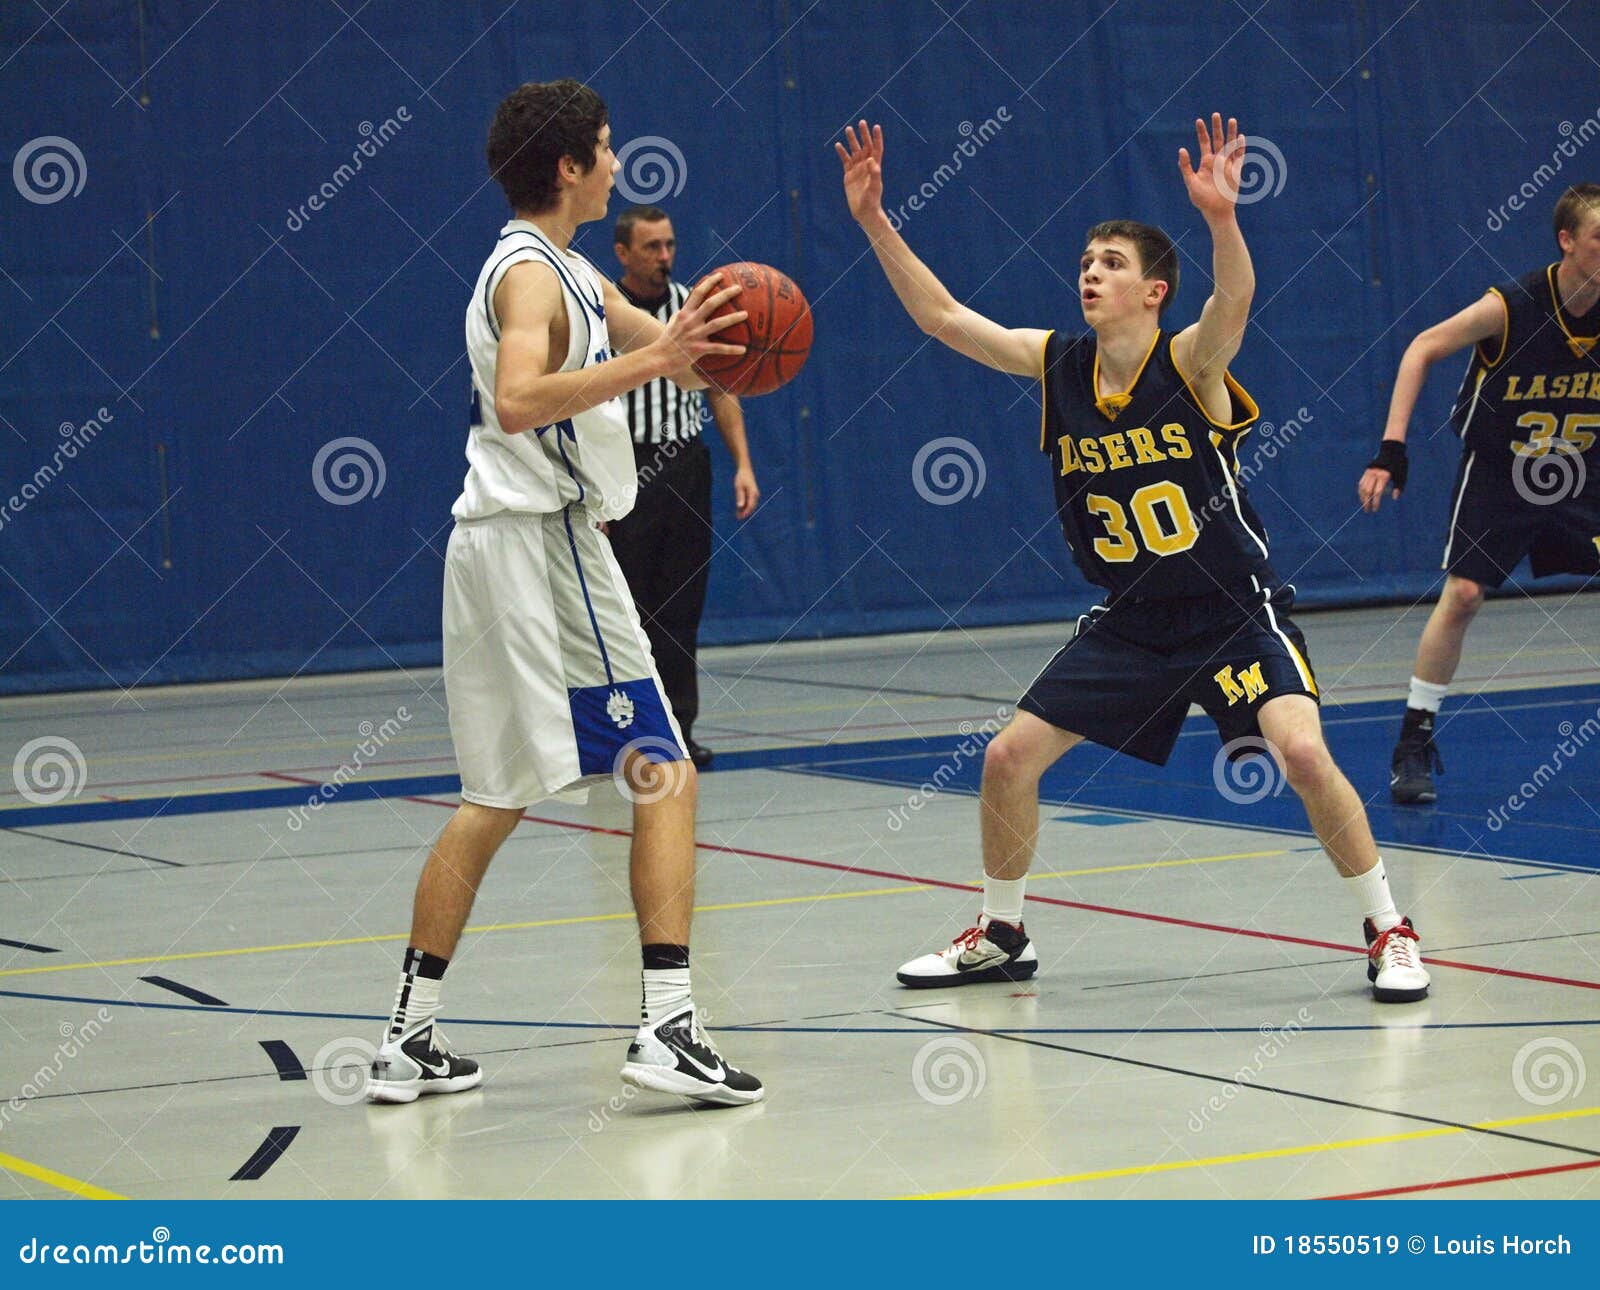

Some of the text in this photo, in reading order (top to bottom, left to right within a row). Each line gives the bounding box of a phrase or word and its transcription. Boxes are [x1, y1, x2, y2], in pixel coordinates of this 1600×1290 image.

[1510, 411, 1600, 458] 35
[1086, 480, 1200, 563] 30
[1213, 661, 1269, 707] KM
